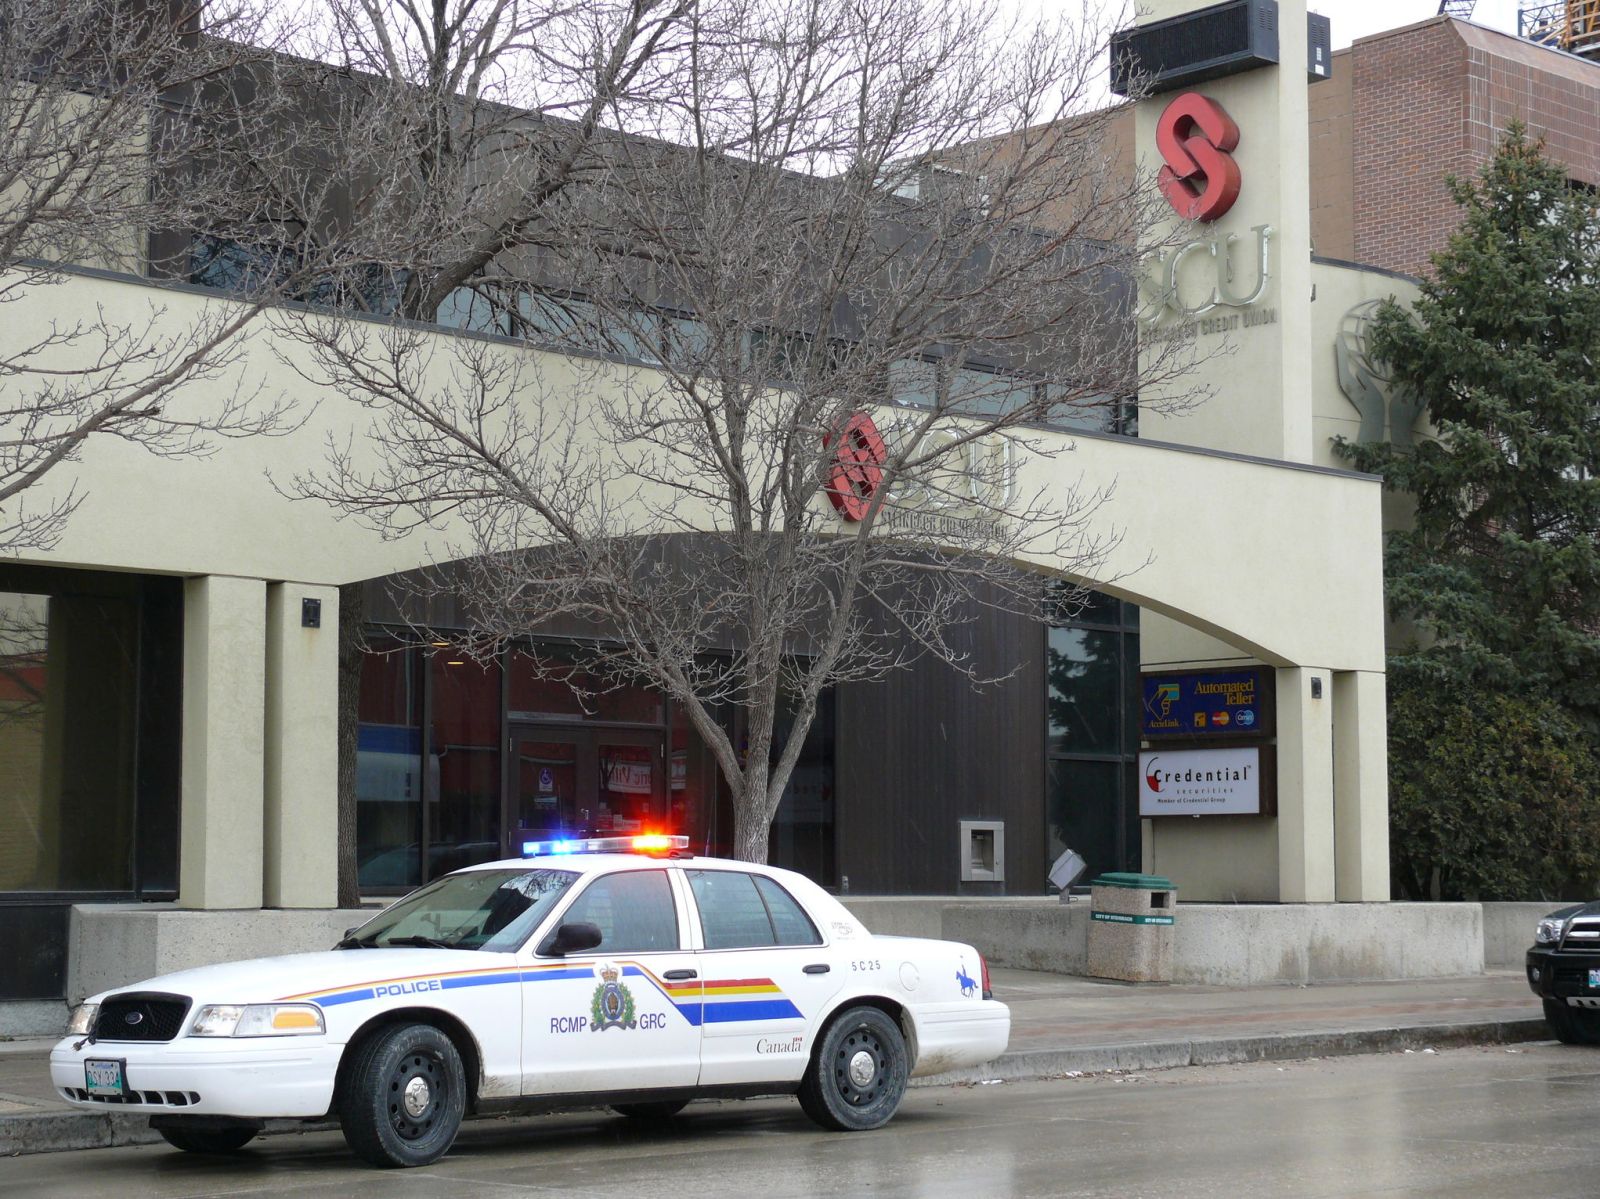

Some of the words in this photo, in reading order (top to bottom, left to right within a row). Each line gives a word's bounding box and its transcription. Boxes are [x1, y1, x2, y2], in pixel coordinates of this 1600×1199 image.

[1200, 314, 1239, 335] CREDIT
[1242, 308, 1278, 328] UNION
[1194, 678, 1254, 694] Automated
[1224, 692, 1255, 705] Teller
[1154, 766, 1247, 783] Credential
[1210, 796, 1226, 804] Group
[375, 980, 440, 998] POLICE
[550, 1016, 587, 1033] RCMP
[640, 1012, 666, 1030] GRC
[756, 1037, 802, 1054] Canada
